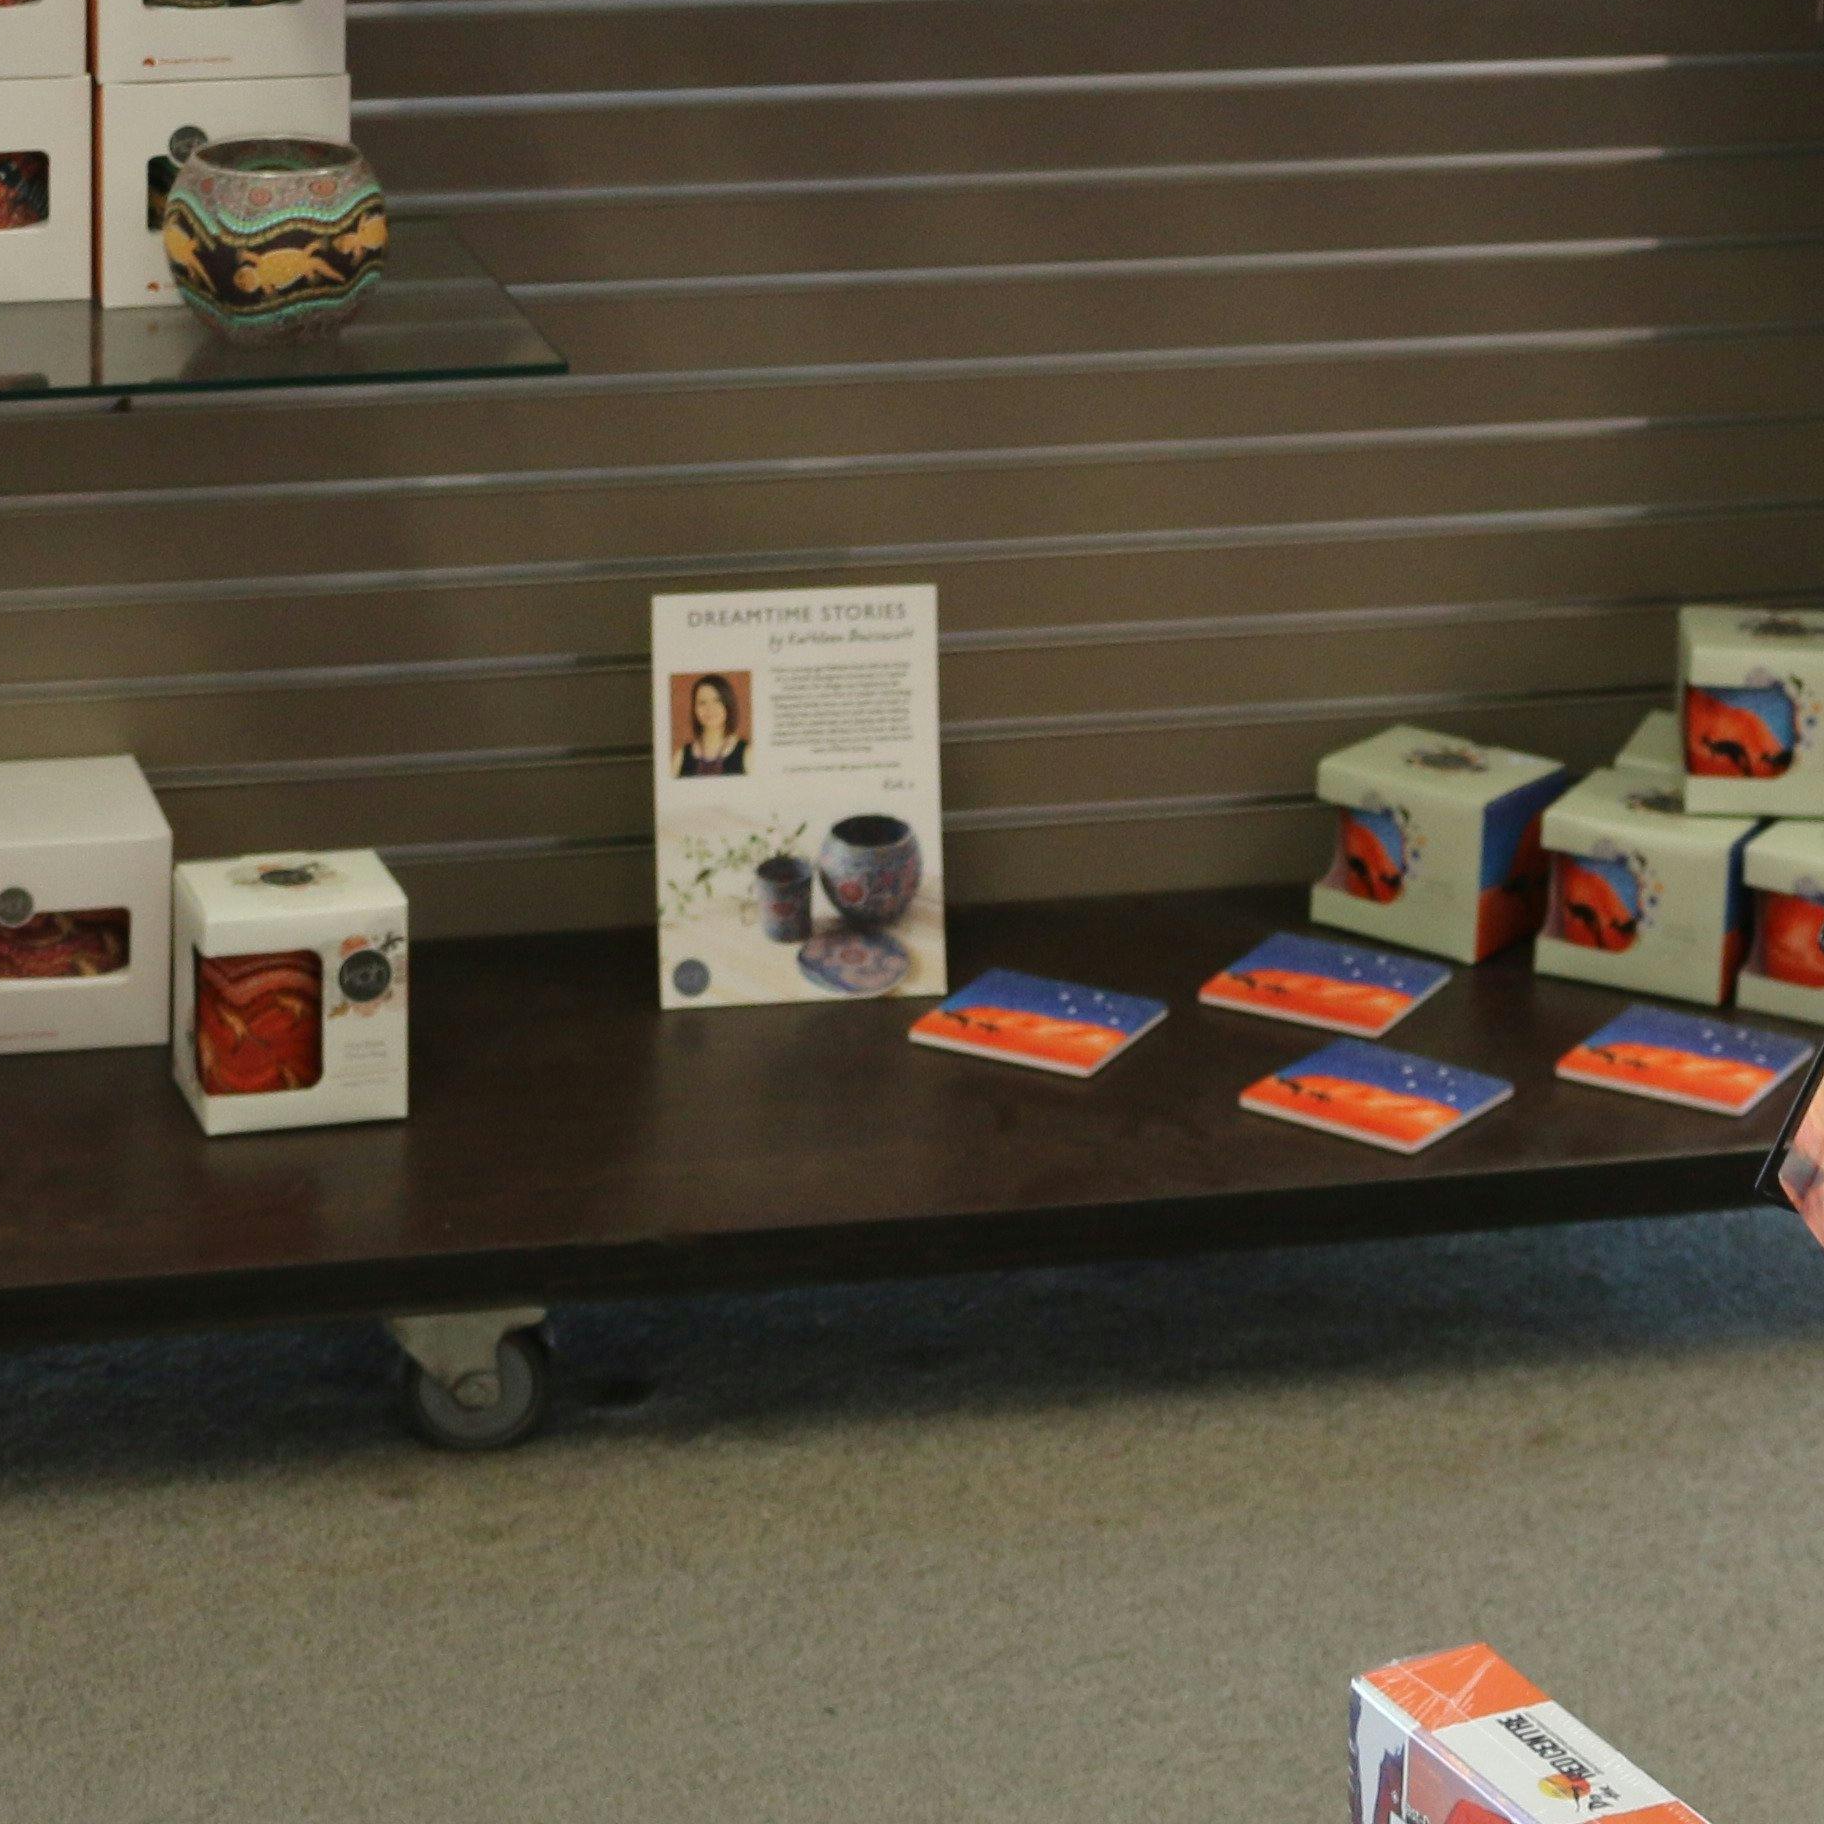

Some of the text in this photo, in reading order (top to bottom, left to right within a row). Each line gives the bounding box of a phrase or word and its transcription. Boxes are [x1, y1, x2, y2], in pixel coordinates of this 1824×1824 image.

[687, 601, 907, 628] DREAMTIME STORIES
[1496, 1712, 1597, 1780] RED CENTRE
